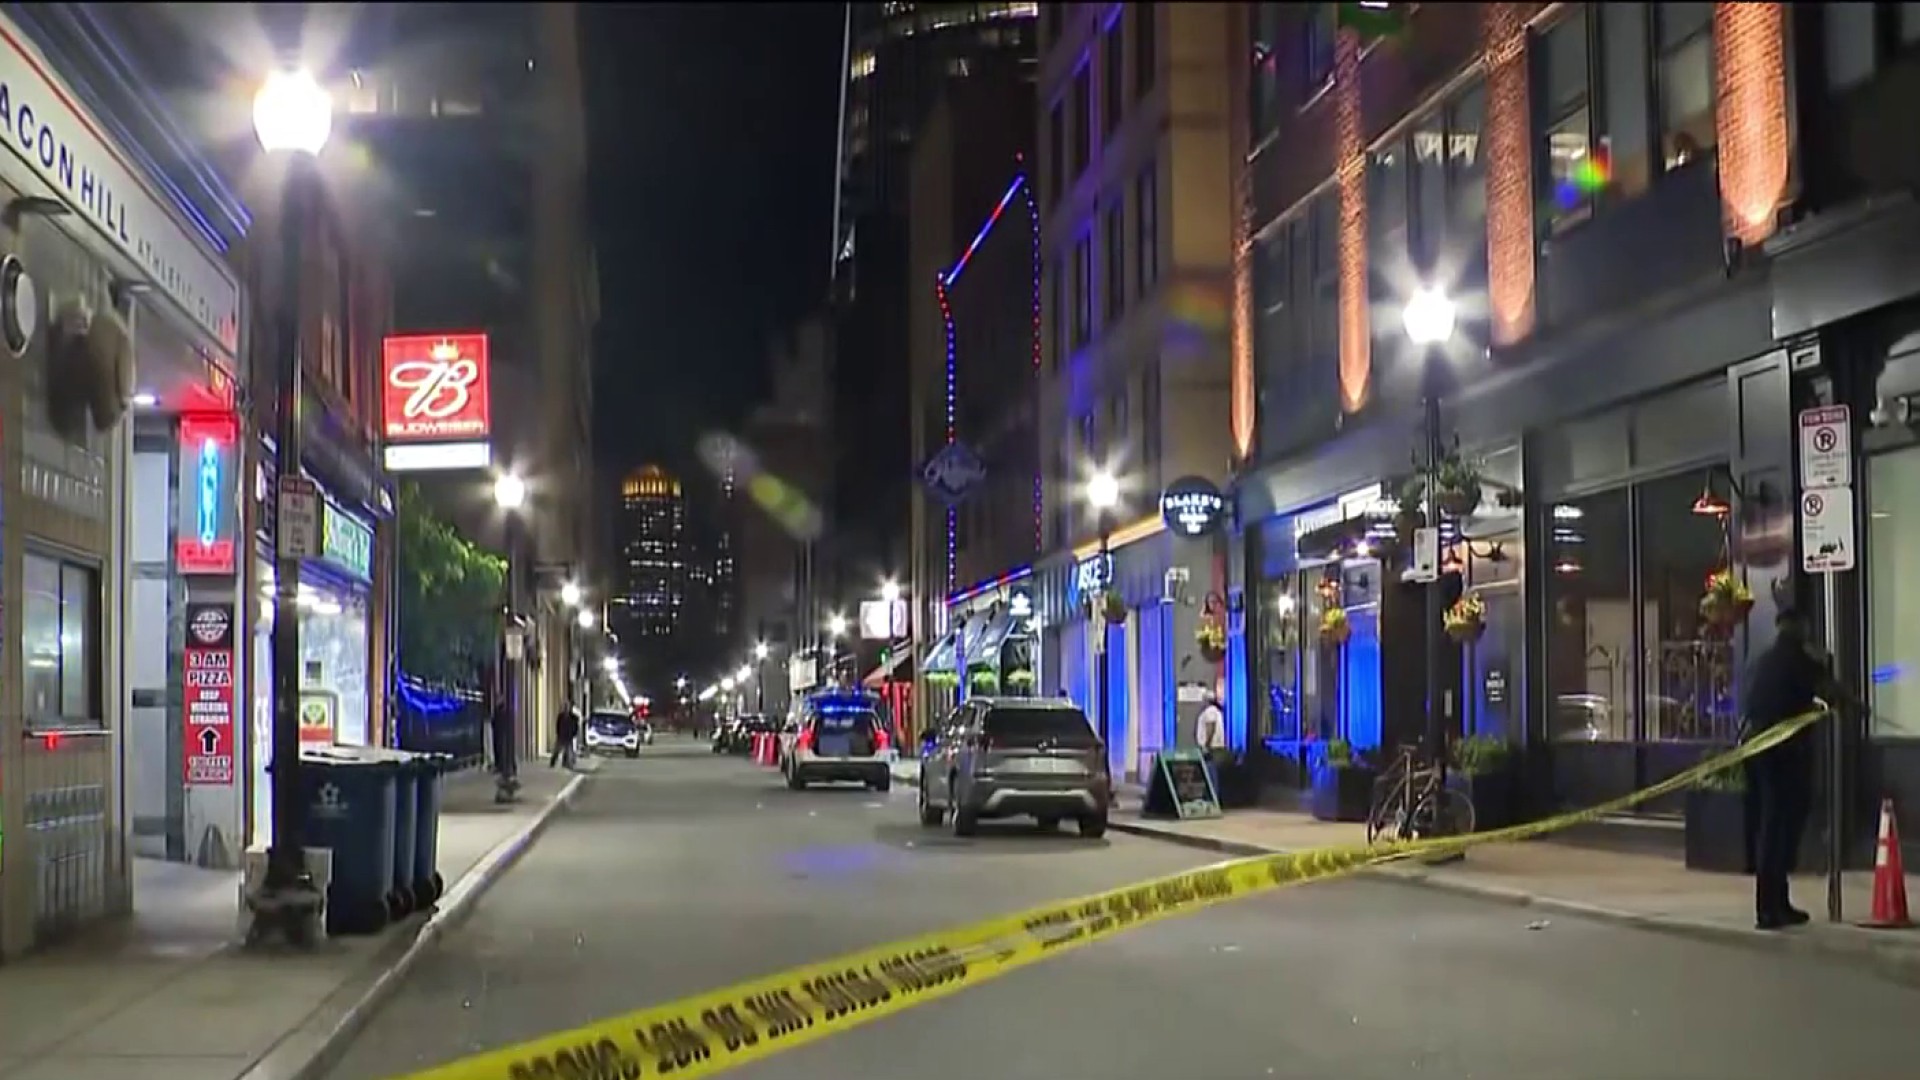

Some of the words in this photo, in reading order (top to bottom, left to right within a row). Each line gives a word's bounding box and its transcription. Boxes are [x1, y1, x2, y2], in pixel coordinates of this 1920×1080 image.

[0, 81, 74, 190] ACON
[80, 164, 129, 243] HILL
[387, 420, 484, 437] BUDWEISER
[1164, 492, 1222, 511] BLAKE'S
[187, 670, 232, 687] PIZZA
[204, 652, 229, 668] AM
[743, 988, 814, 1040] LINE
[802, 963, 892, 1022] POLICE
[634, 1016, 711, 1075] NOT
[701, 1002, 758, 1052] DO
